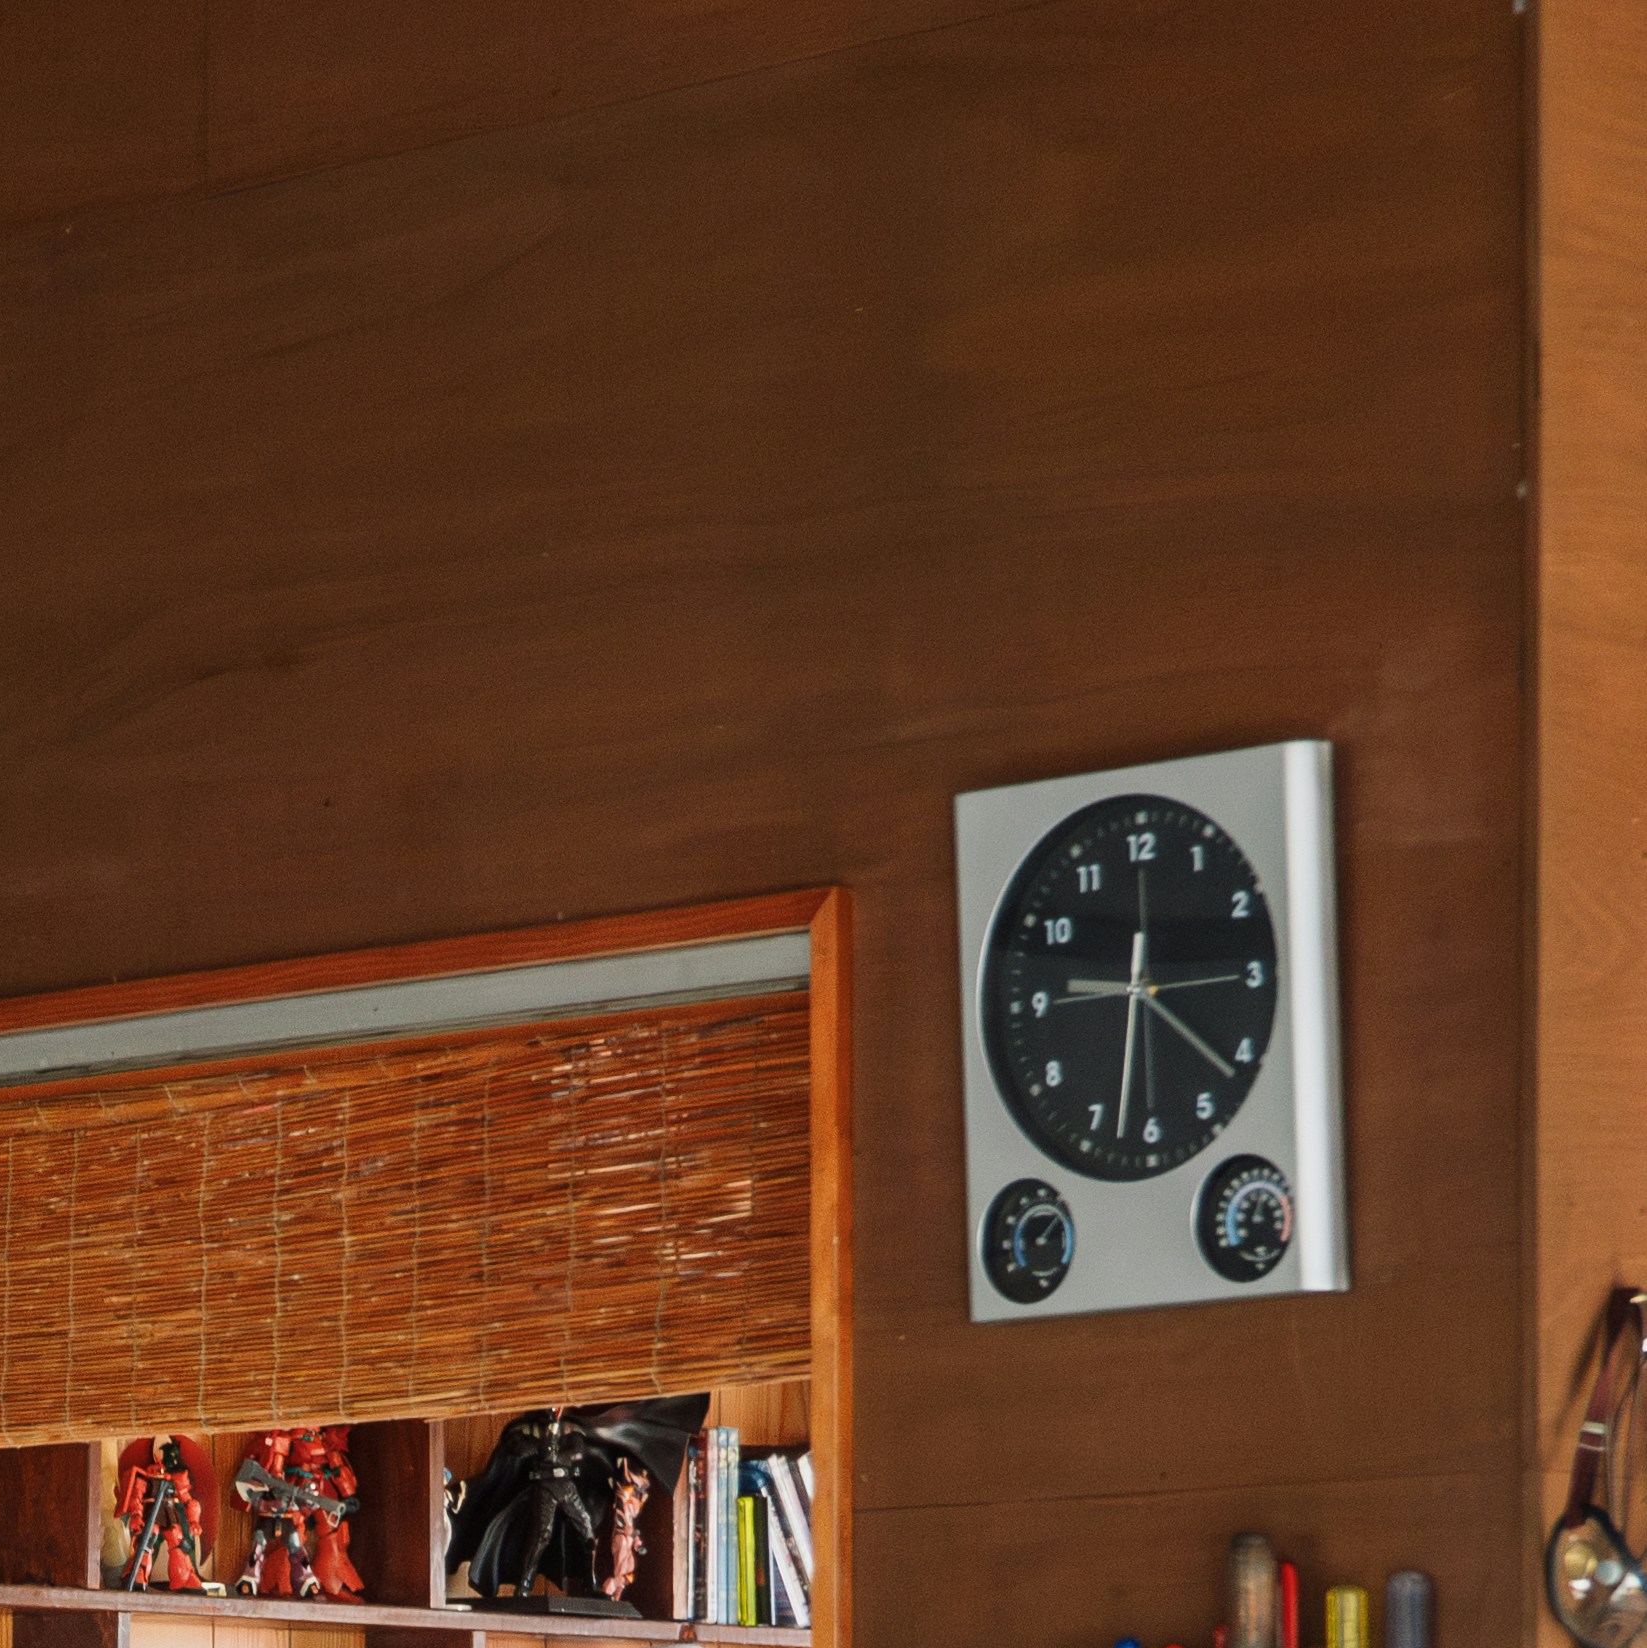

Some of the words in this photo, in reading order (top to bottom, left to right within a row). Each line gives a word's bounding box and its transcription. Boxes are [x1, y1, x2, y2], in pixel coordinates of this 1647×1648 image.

[1127, 834, 1156, 861] 12
[1190, 847, 1204, 869] 1
[1077, 866, 1101, 891] 11
[1232, 893, 1249, 917] 2
[1045, 920, 1071, 943] 10
[1246, 962, 1262, 986] 3
[1032, 993, 1047, 1017] 9
[1235, 1039, 1253, 1062] 4
[1045, 1062, 1062, 1086] 8
[1089, 1105, 1103, 1129] 7
[1196, 1094, 1213, 1118] 5
[1144, 1119, 1160, 1143] 6
